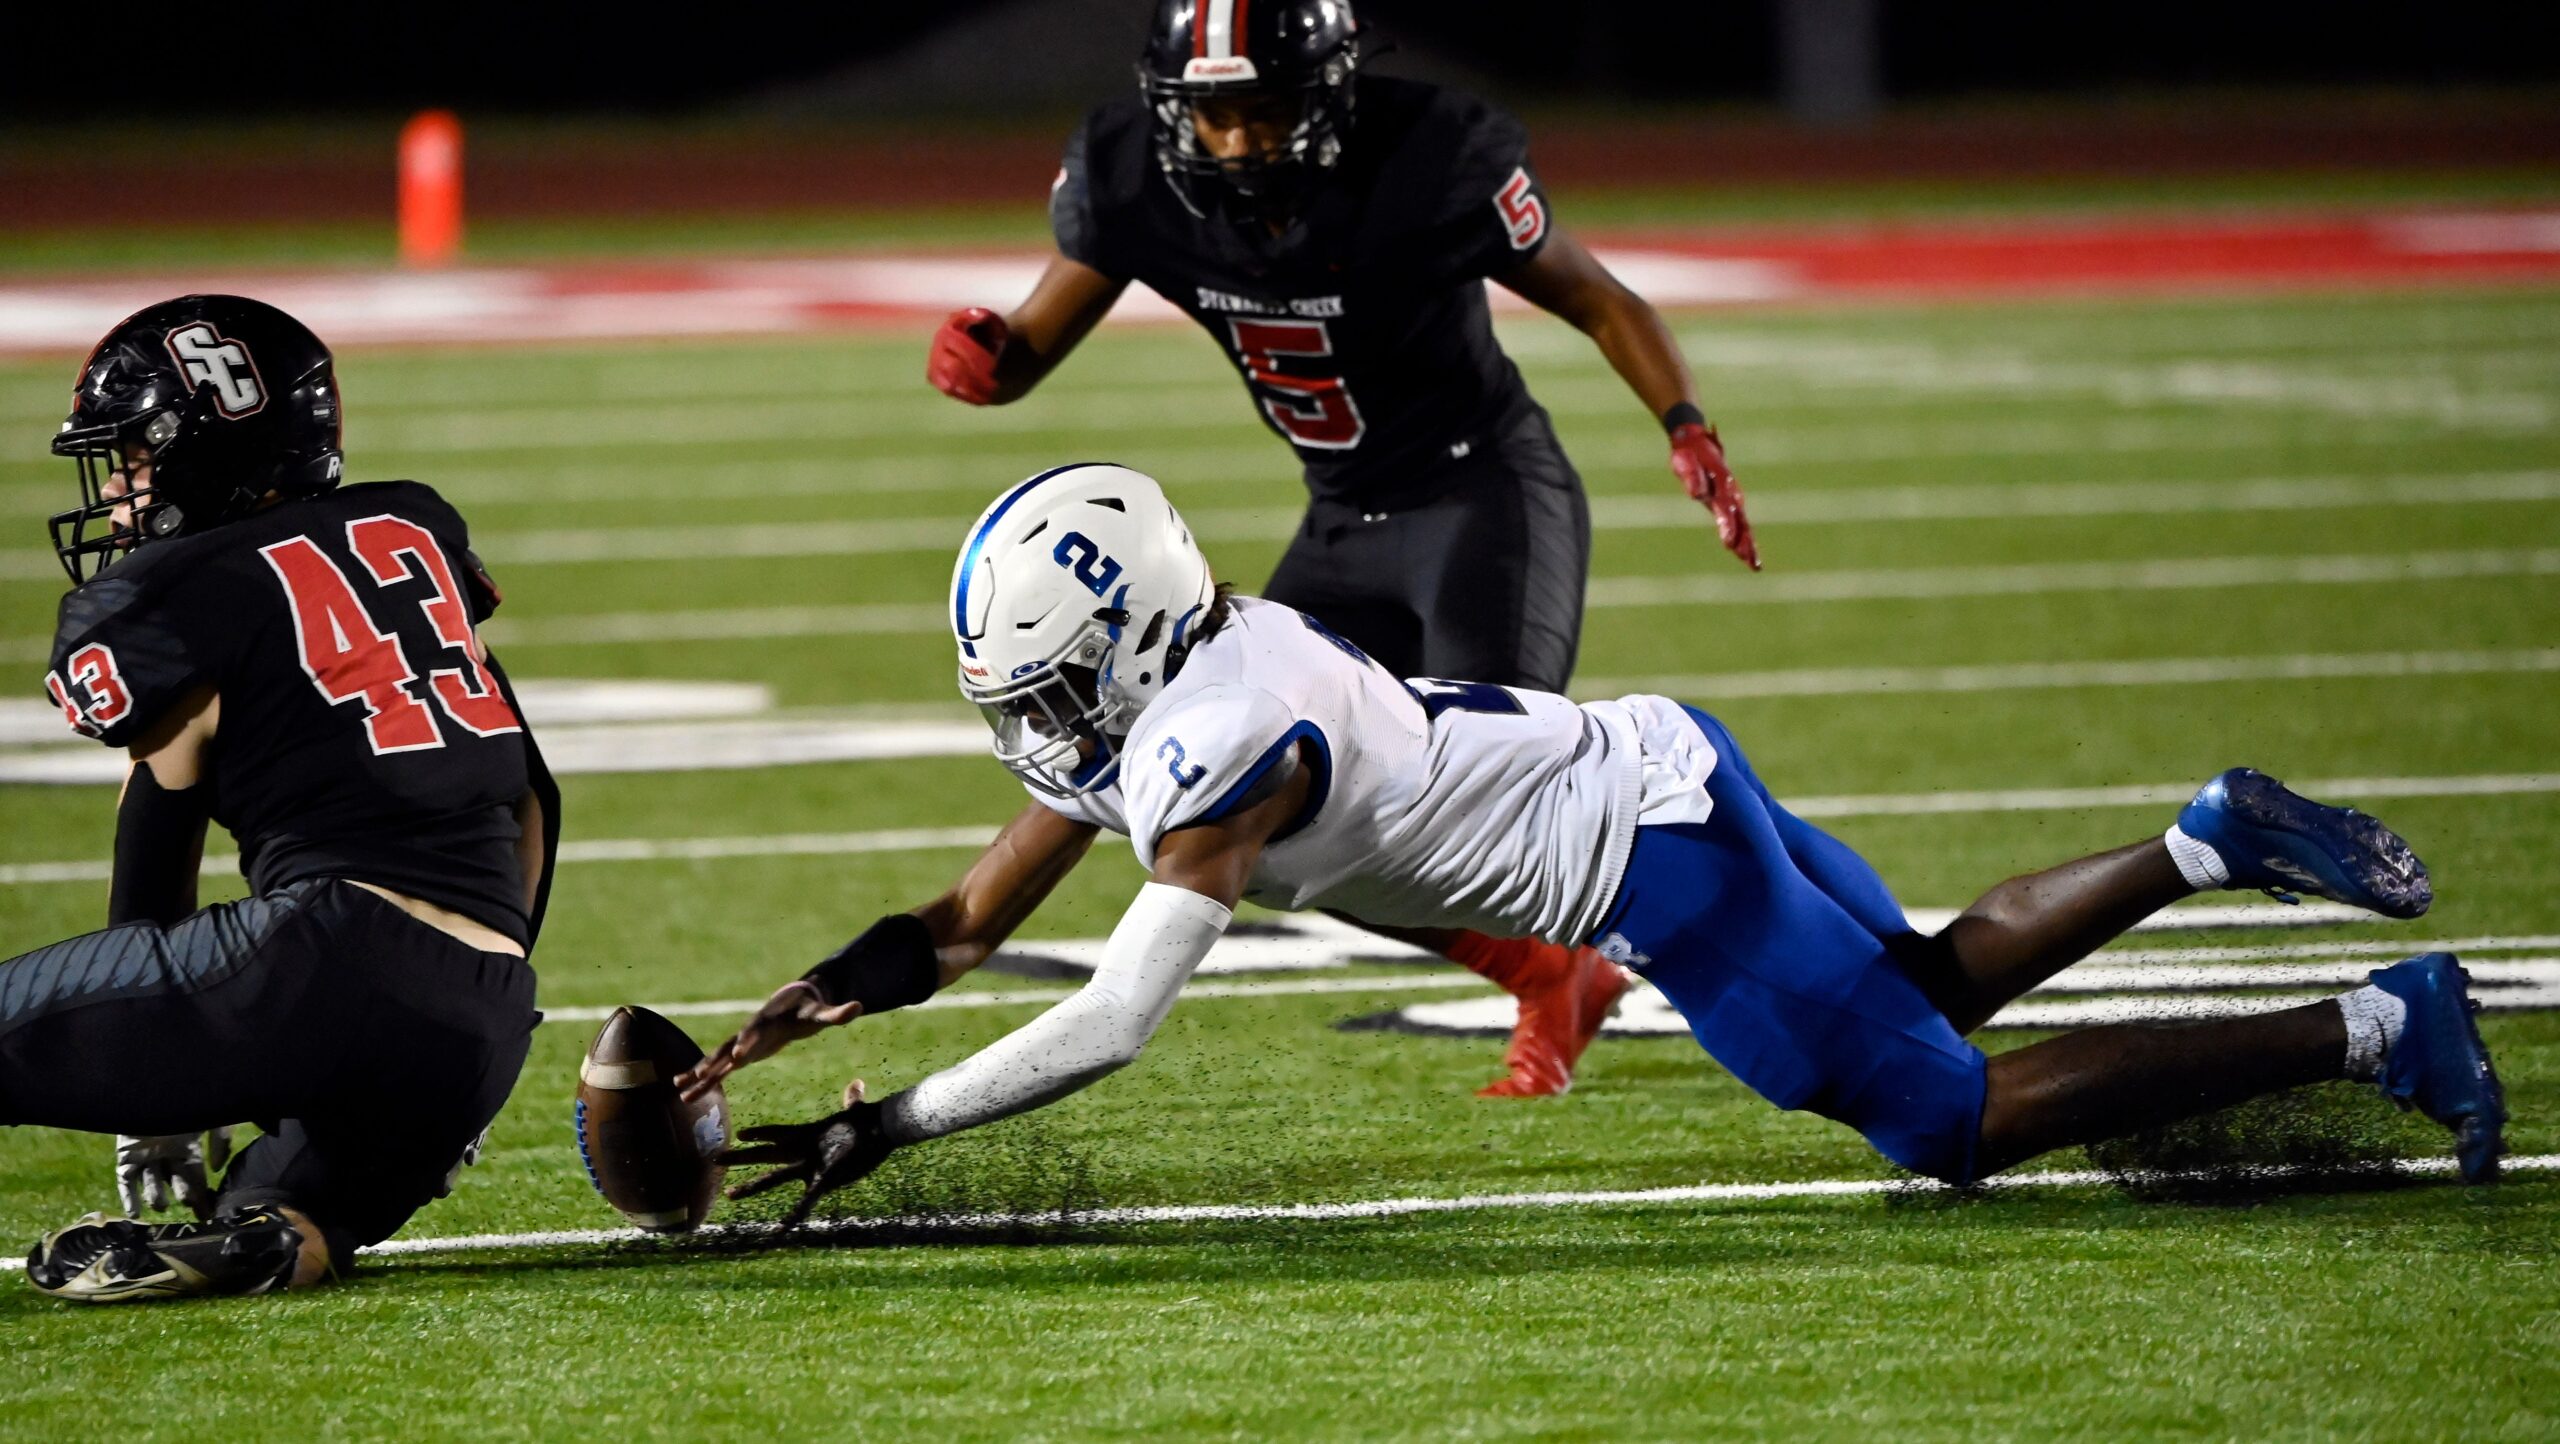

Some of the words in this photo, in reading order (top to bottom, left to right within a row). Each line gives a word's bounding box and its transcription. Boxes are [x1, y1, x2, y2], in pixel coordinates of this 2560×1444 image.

[1493, 166, 1548, 251] 5
[1289, 295, 1344, 317] CREEK
[165, 321, 268, 420] SC
[1231, 317, 1366, 450] 5
[1053, 531, 1123, 598] 2
[258, 513, 523, 756] 43
[1156, 736, 1208, 790] 2
